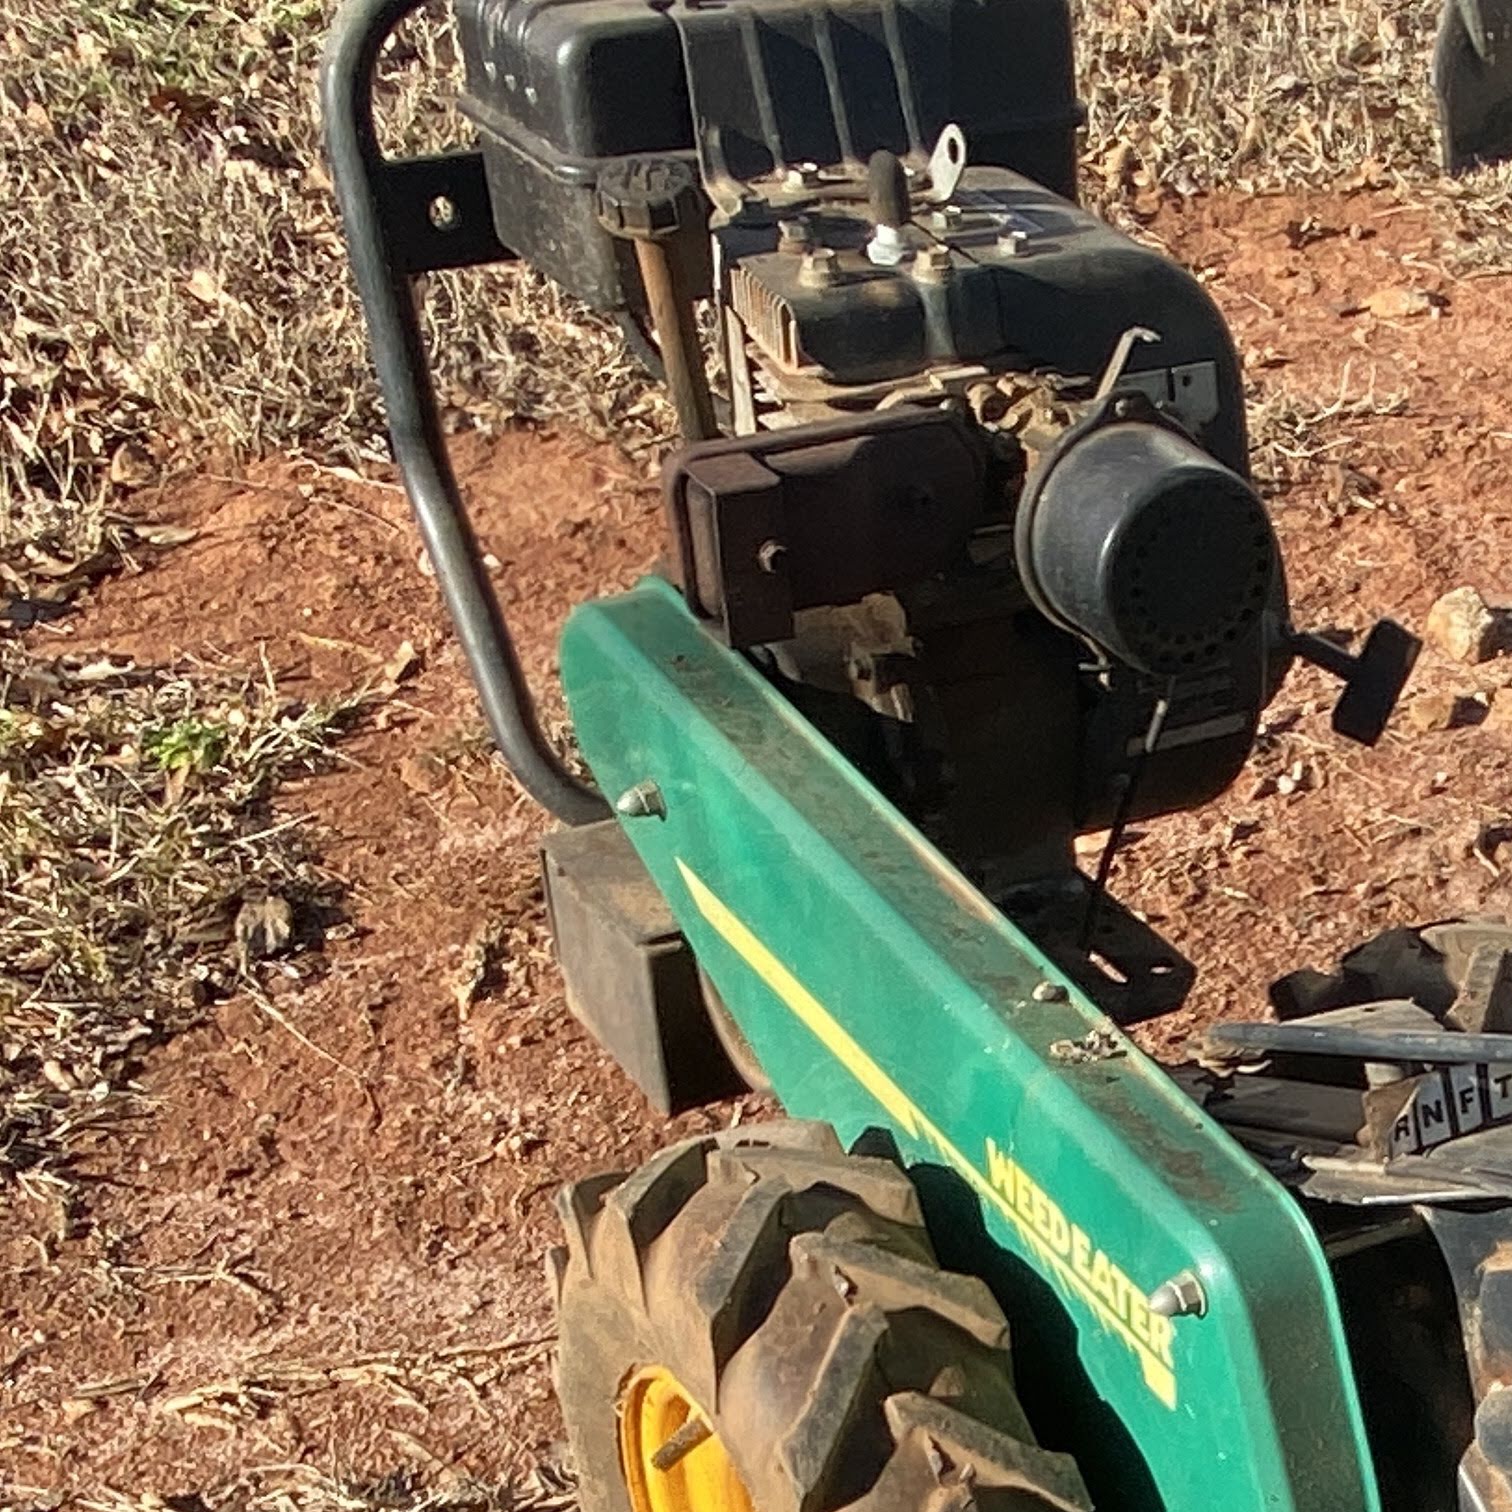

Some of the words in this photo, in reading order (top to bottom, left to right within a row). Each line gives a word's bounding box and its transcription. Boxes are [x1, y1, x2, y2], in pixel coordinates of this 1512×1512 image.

[1421, 1100, 1444, 1128] N
[1459, 1087, 1475, 1114] F
[1493, 1073, 1512, 1099] T
